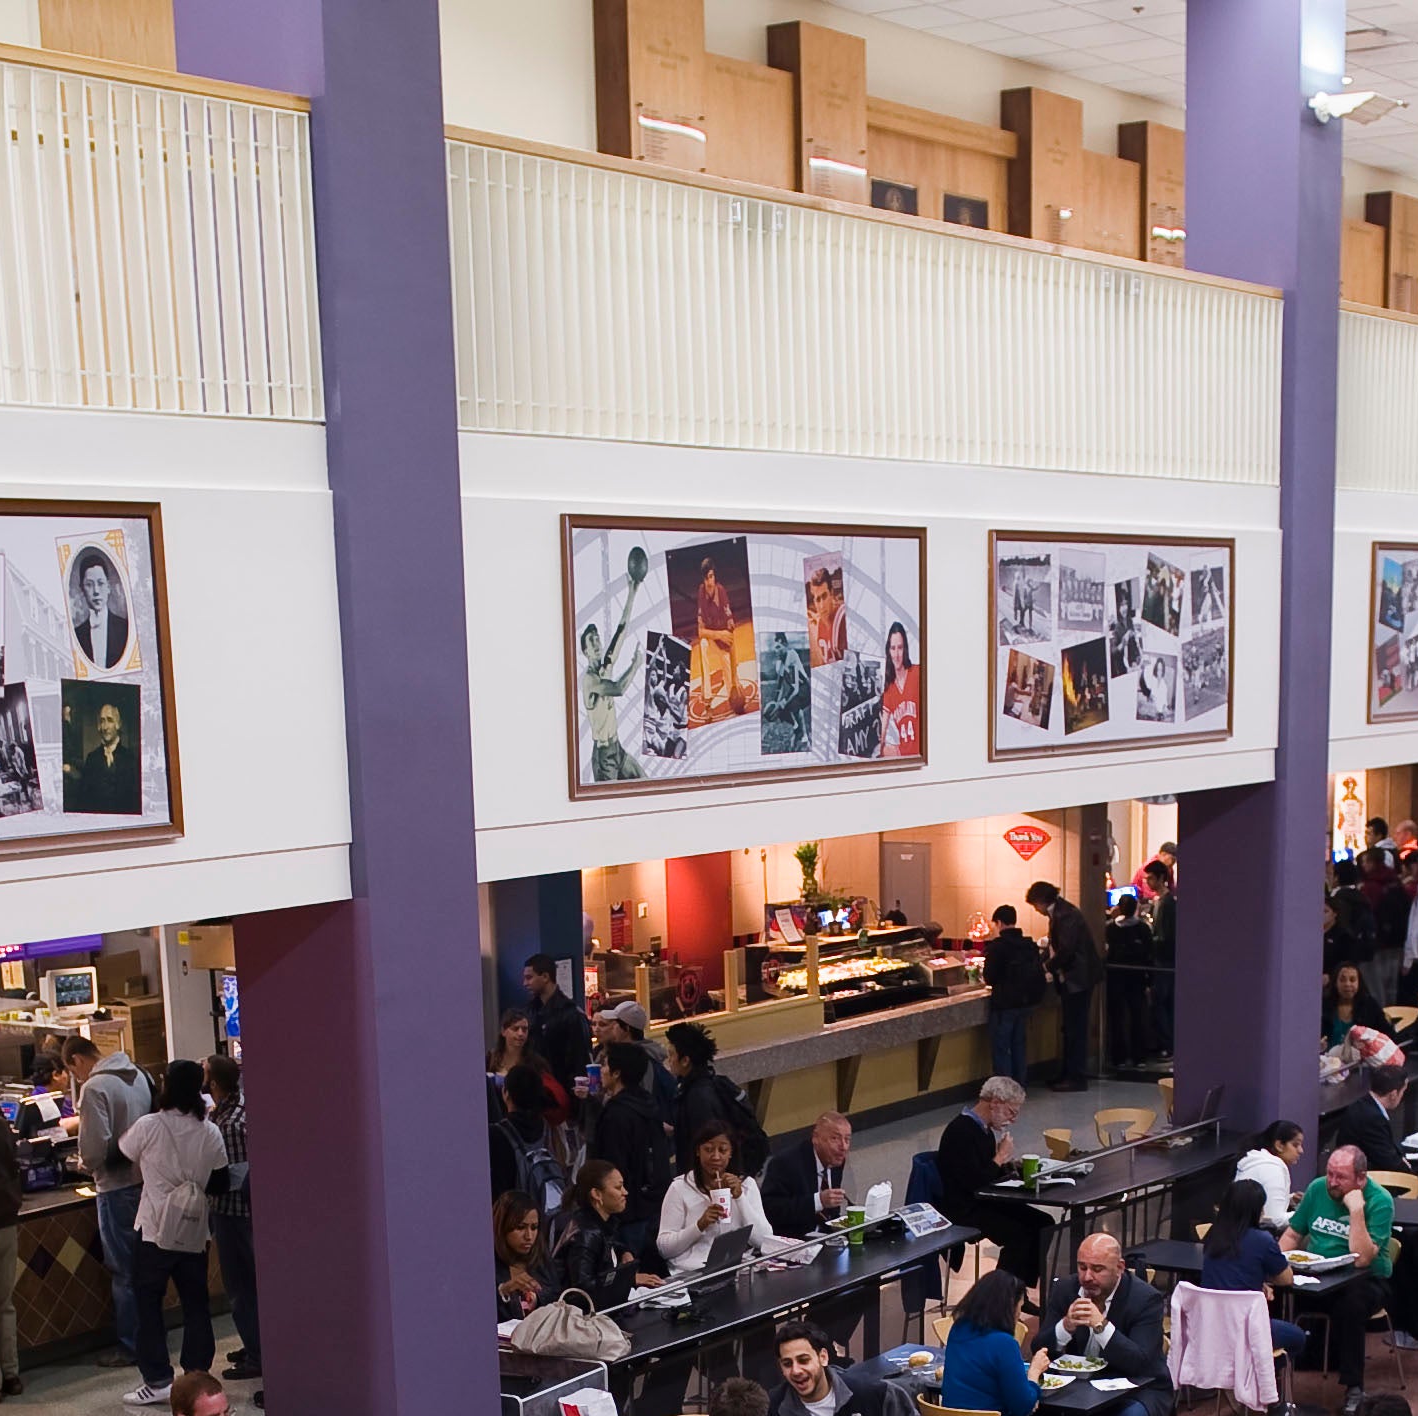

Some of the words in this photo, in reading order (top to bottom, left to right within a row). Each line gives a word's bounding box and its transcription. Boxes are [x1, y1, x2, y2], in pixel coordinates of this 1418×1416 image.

[841, 703, 873, 729] DRAFT
[846, 726, 870, 756] AMY
[900, 720, 915, 742] 44
[1009, 831, 1030, 841] Thank
[1029, 831, 1044, 843] You
